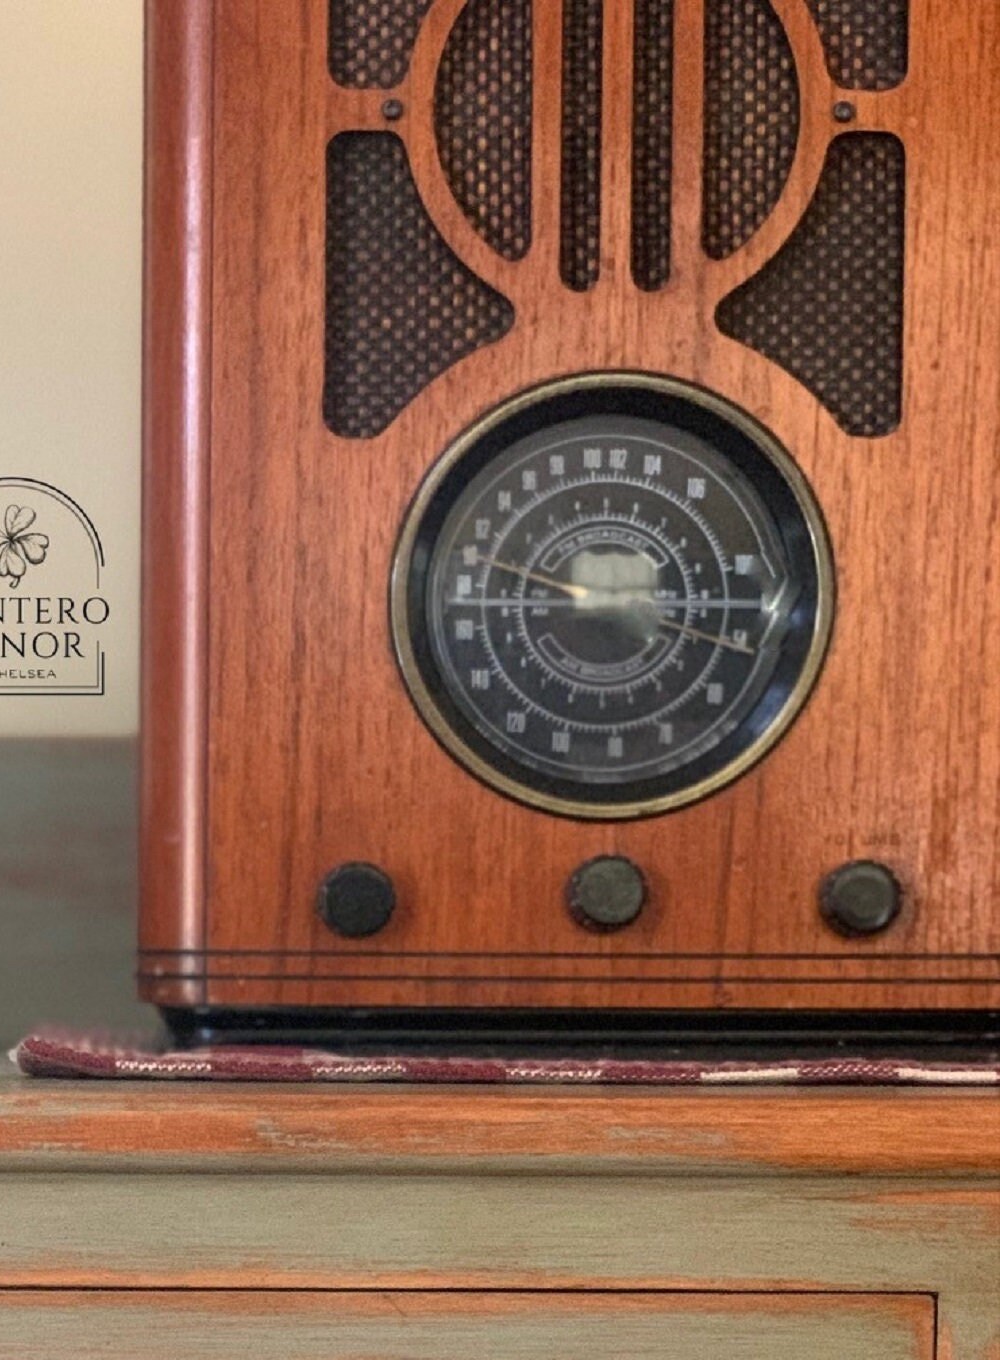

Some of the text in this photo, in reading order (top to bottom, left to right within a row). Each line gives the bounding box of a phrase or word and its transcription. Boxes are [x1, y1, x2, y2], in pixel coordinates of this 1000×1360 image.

[583, 448, 602, 468] 100
[609, 449, 627, 469] 102
[643, 455, 661, 475] 104
[687, 478, 706, 499] 106
[507, 711, 526, 733] 120
